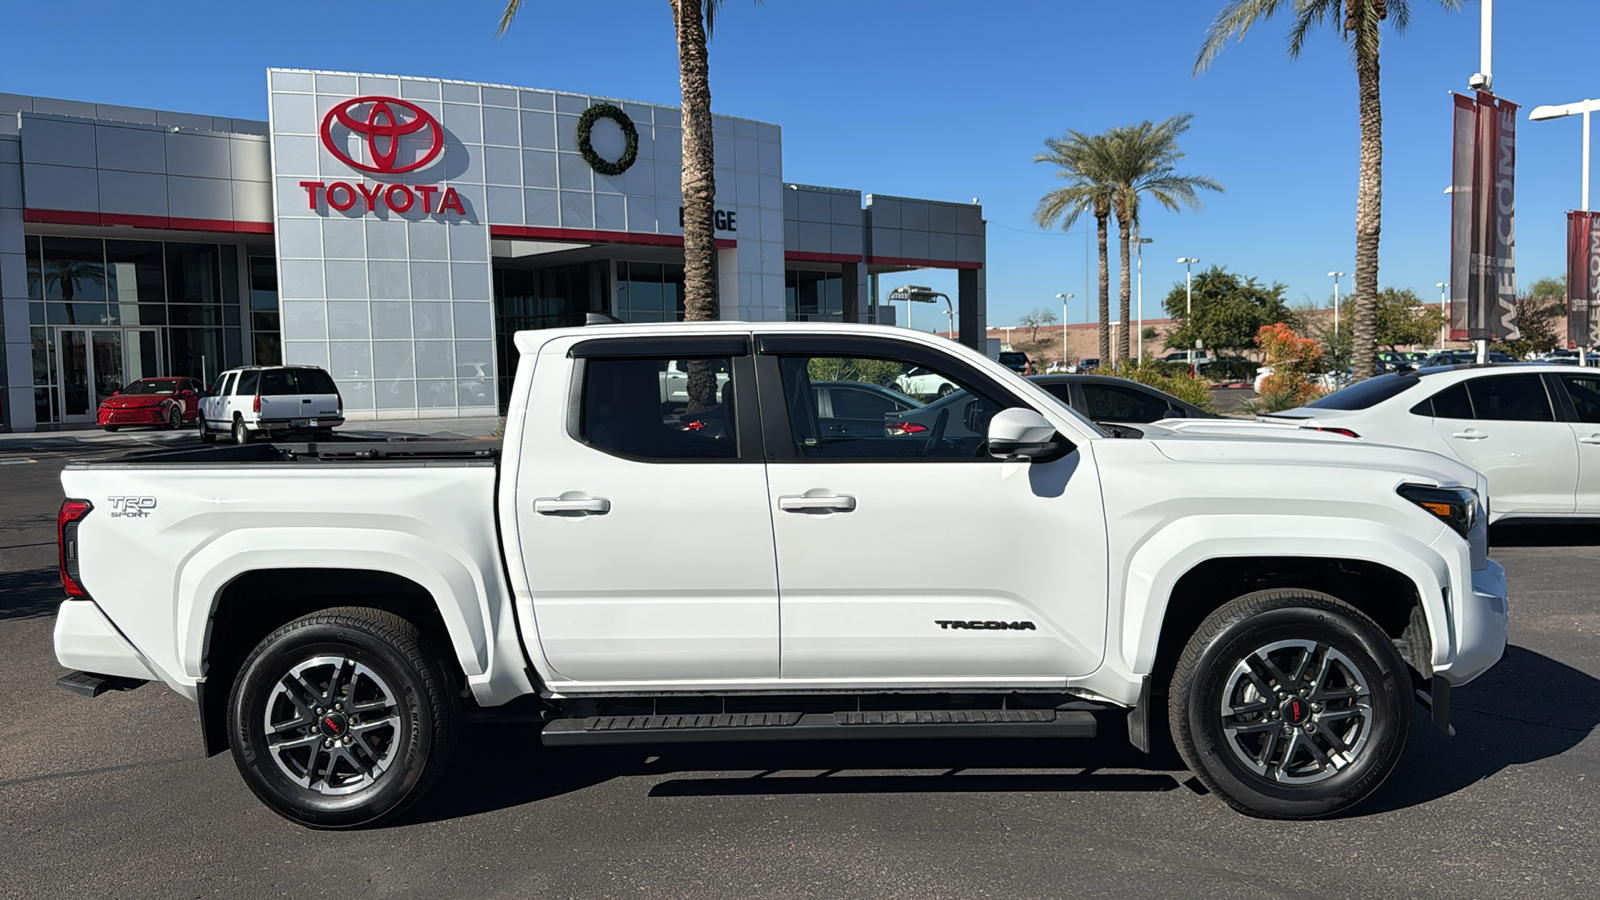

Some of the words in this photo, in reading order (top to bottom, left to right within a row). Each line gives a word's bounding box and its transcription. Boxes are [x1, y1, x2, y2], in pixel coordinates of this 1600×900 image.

[299, 181, 466, 215] TOYOTA
[1496, 106, 1521, 341] WELCOME
[107, 496, 157, 513] TRD
[934, 620, 1037, 631] TACOMA
[325, 718, 340, 734] TRD
